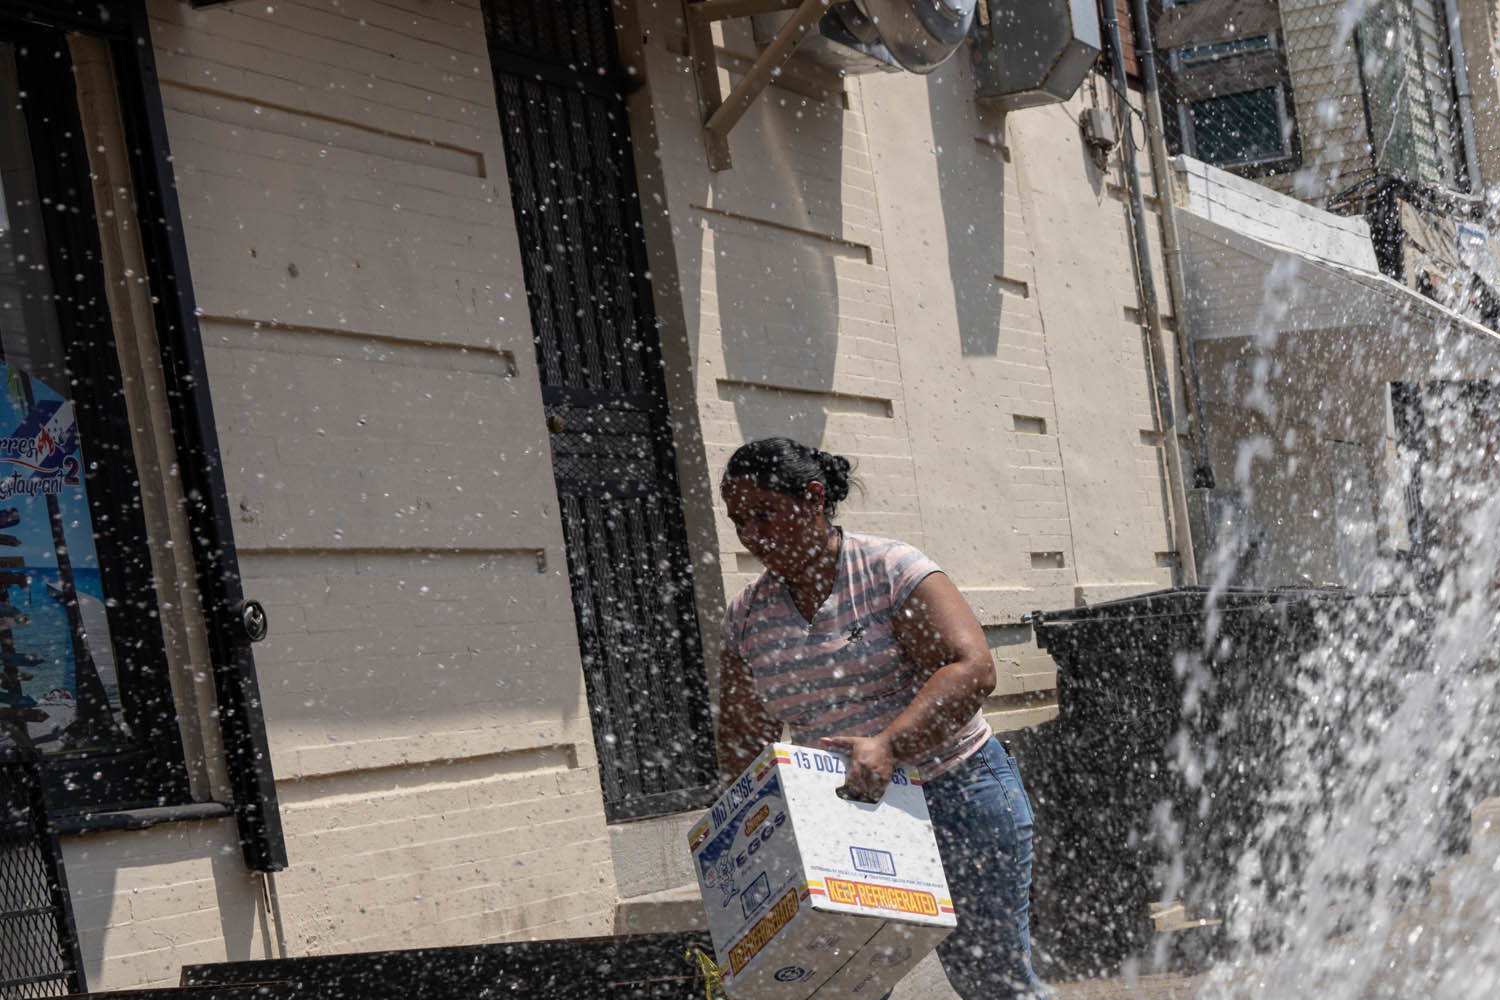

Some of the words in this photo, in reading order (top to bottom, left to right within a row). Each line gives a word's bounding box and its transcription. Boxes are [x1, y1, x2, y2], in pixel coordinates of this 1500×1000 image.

[64, 457, 80, 486] 2
[793, 751, 811, 769] 15
[736, 811, 786, 868] EGGS
[827, 879, 858, 902] KEEP
[857, 884, 938, 914] REFRIGERATED
